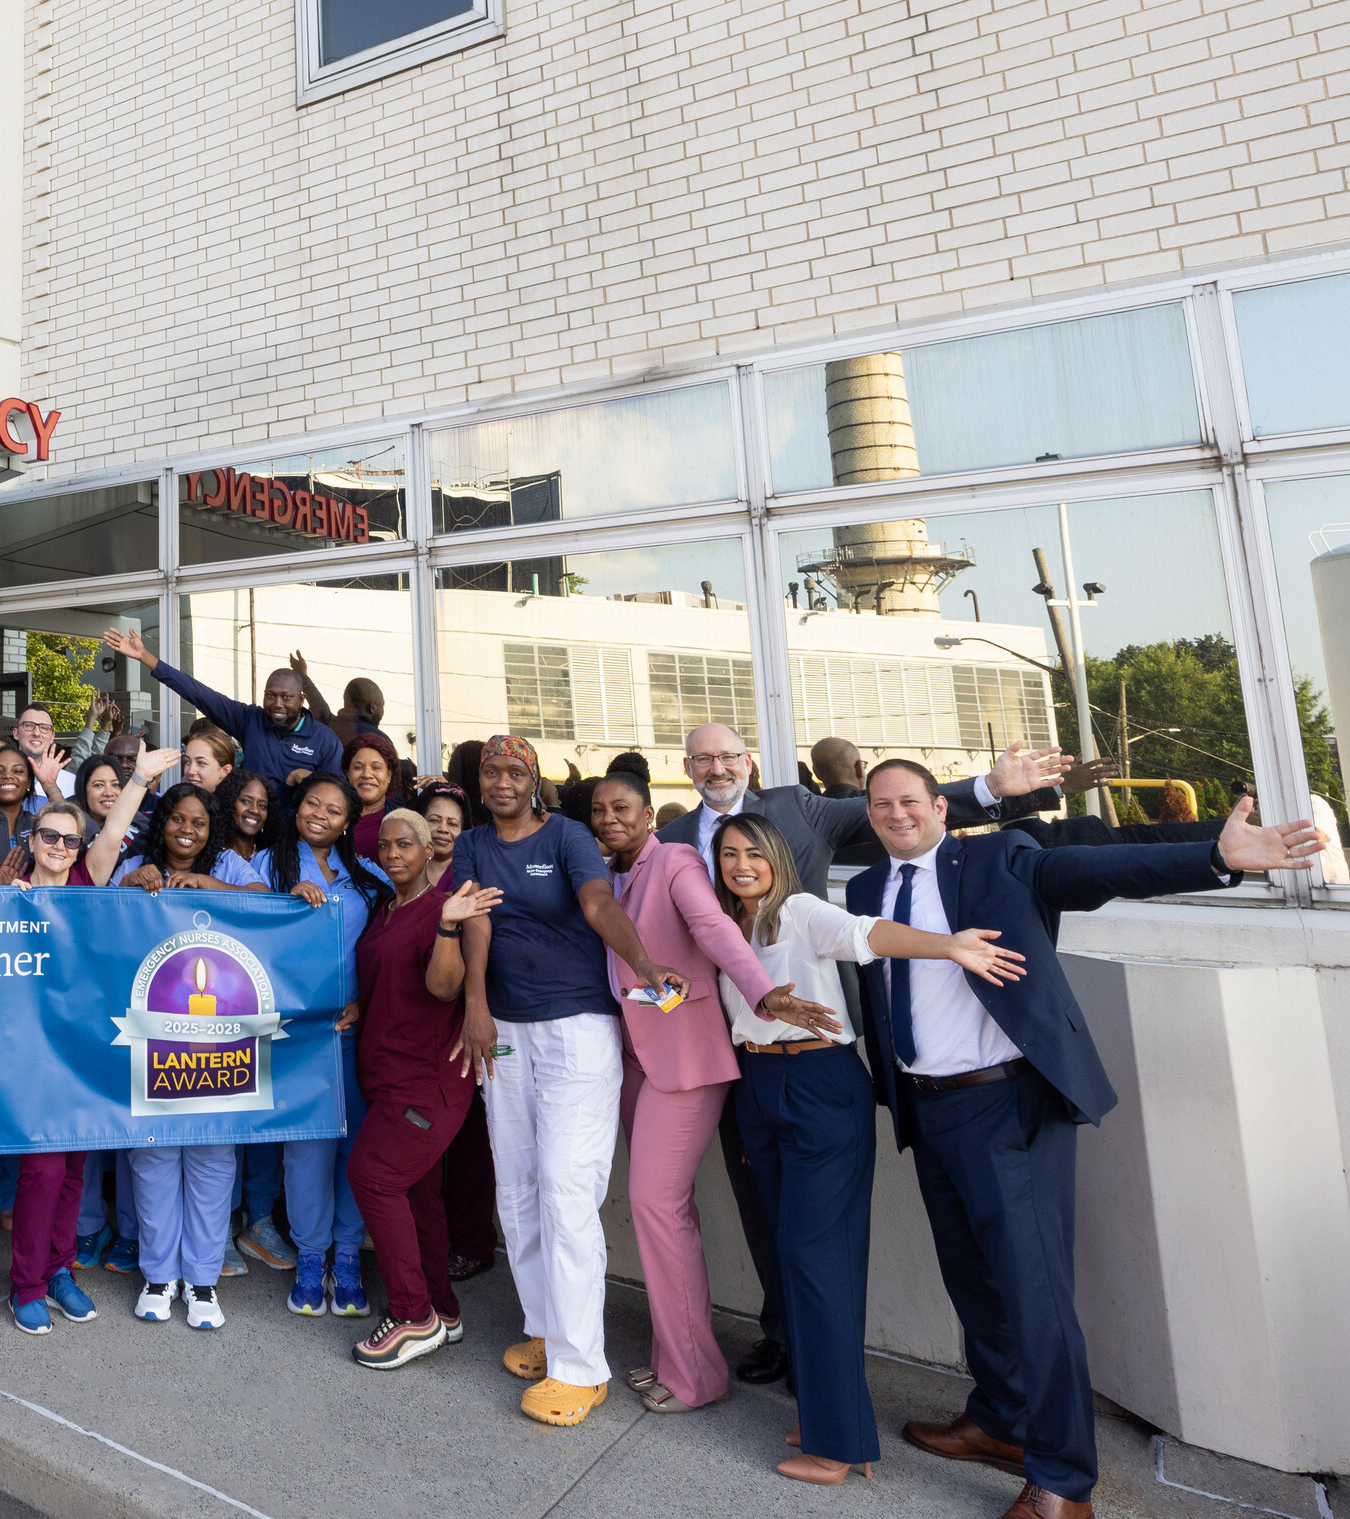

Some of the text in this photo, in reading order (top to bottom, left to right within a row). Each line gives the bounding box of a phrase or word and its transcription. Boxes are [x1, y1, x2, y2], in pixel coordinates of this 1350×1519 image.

[135, 932, 270, 1001] EMERGENCY NURSES ASSOCIATION
[163, 1020, 242, 1035] 2025–2028
[153, 1048, 251, 1070] LANTERN
[153, 1067, 250, 1091] AWARD
